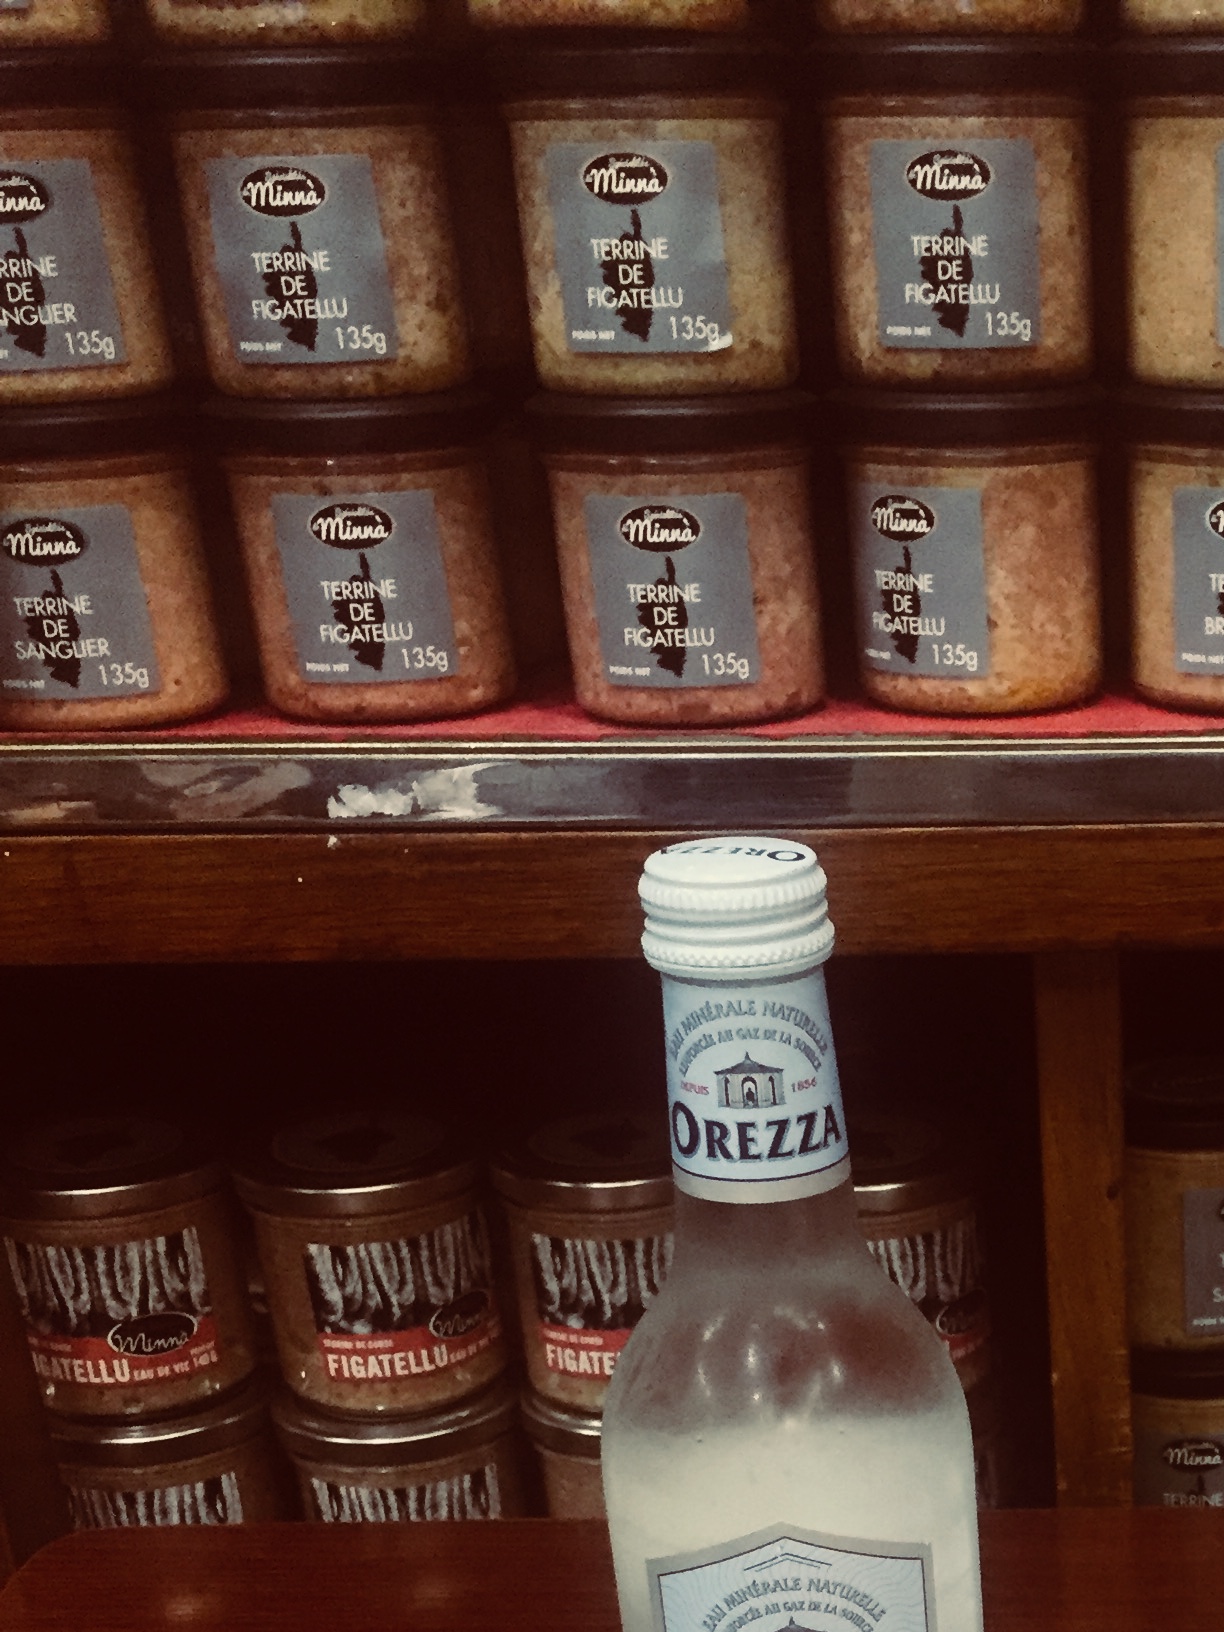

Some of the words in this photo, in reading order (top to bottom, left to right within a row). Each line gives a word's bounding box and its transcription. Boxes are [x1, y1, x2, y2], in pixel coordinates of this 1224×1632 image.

[590, 238, 669, 260] TERRINE
[911, 235, 989, 257] TERRINE
[0, 256, 58, 278] RRINE
[251, 250, 331, 273] TERRINE
[937, 260, 964, 281] DE
[618, 264, 645, 285] DE
[7, 282, 34, 303] DE
[281, 276, 308, 296] DE
[905, 283, 1001, 304] FIGATELLU
[252, 298, 349, 319] FIGATELLU
[587, 287, 684, 308] FIGATELLU
[0, 305, 77, 326] NGLIER
[985, 311, 1032, 340] 135g
[334, 325, 387, 353] 135g
[669, 315, 720, 343] 135g
[65, 331, 115, 359] 135g
[320, 578, 399, 600] TERRINE
[874, 569, 934, 594] TERRINE
[626, 584, 702, 605] TERRINE
[893, 595, 913, 614] DE
[14, 595, 95, 617] TERRINE
[349, 603, 376, 622] DE
[653, 606, 679, 626] DE
[43, 619, 70, 638] DE
[319, 622, 414, 643] FIGATELLU
[871, 612, 946, 636] FIGATELLU
[15, 637, 111, 660] SANGLIER
[624, 628, 716, 648] FIGATELLU
[400, 648, 449, 672] 135g
[700, 654, 750, 680] 135g
[931, 644, 979, 672] 135g
[98, 663, 150, 689] 135g
[680, 1000, 757, 1036] MINÉRALE
[671, 1102, 842, 1163] OREZZA
[32, 1351, 131, 1384] IGATELLU
[327, 1344, 449, 1379] FIGATELLU
[546, 1343, 621, 1376] FIGATE
[703, 1602, 728, 1632] EAU
[722, 1577, 803, 1611] MINÉRALE
[807, 1578, 887, 1624] NATURELLE
[764, 1603, 781, 1617] AU
[783, 1601, 805, 1613] GAZ
[807, 1601, 821, 1612] DE
